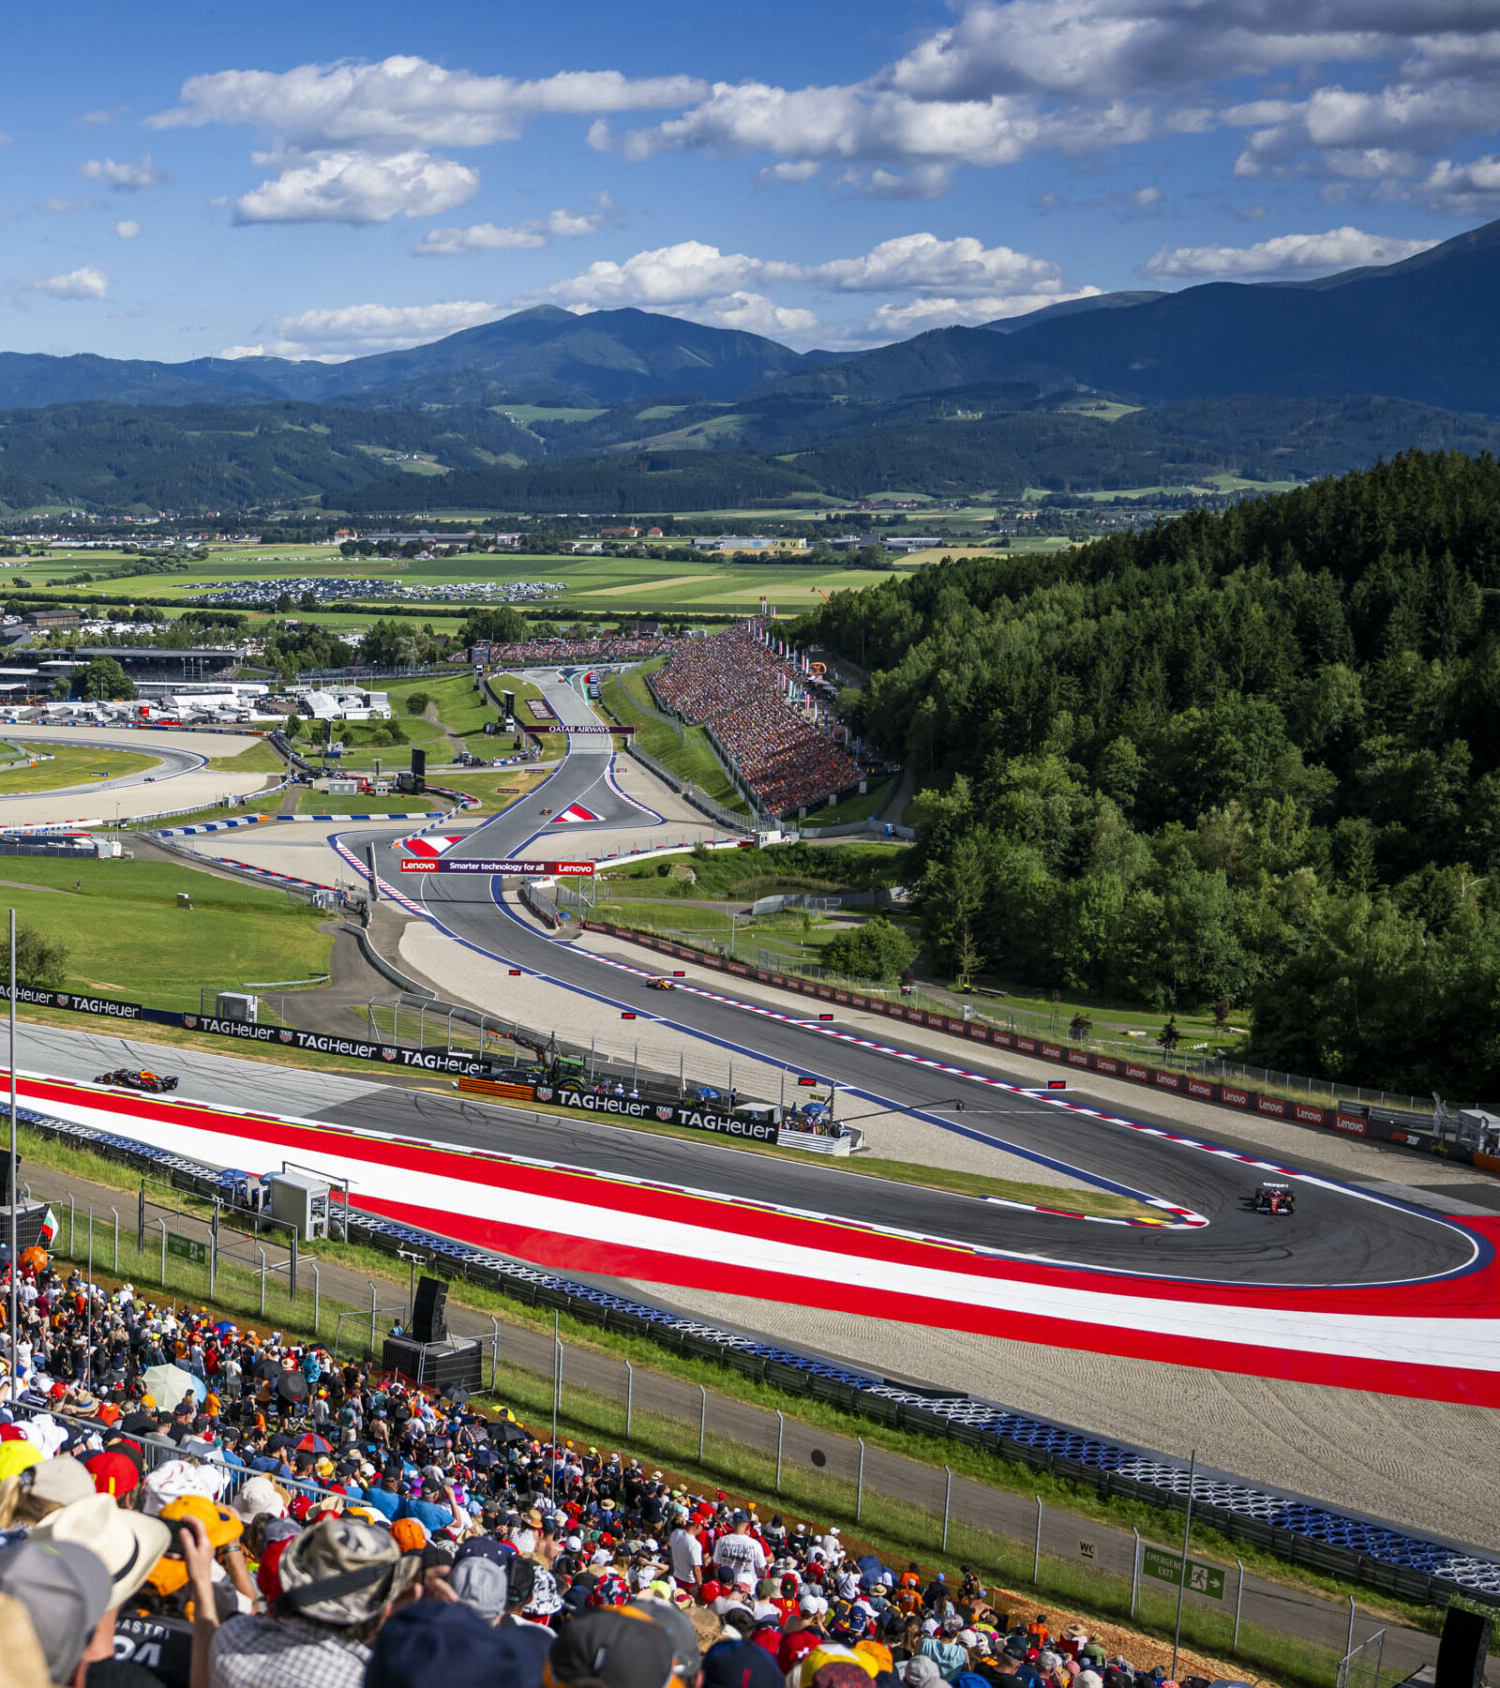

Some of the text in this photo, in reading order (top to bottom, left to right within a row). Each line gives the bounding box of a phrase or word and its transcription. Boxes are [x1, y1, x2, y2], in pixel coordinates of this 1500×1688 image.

[549, 726, 610, 734] QATAR AIRWAYS
[402, 859, 435, 869] Lenovo
[449, 862, 479, 870] Smarter
[481, 863, 522, 872] technology
[558, 864, 591, 873] Lenovo
[72, 996, 139, 1018] TAGHeuer
[201, 1017, 275, 1041] TAGHeuer
[297, 1032, 377, 1059] TAGHeuer
[401, 1050, 489, 1075] TAGHeuer
[1097, 1058, 1117, 1072] Lenovo
[1126, 1065, 1147, 1079] Lenovo
[1156, 1073, 1178, 1087] Lenovo
[1188, 1079, 1211, 1096] Lenovo
[557, 1090, 650, 1117] TAGHeuer
[1223, 1090, 1246, 1105] Lenovo
[1259, 1098, 1283, 1114] Lenovo
[1296, 1106, 1322, 1123] Lenovo
[678, 1109, 775, 1140] TAGHeuer
[1337, 1116, 1363, 1133] Lenovo
[1080, 1541, 1094, 1554] WC
[1146, 1551, 1185, 1571] EMERGENC
[1158, 1566, 1174, 1579] EXIT
[116, 1618, 171, 1640] ASTRI
